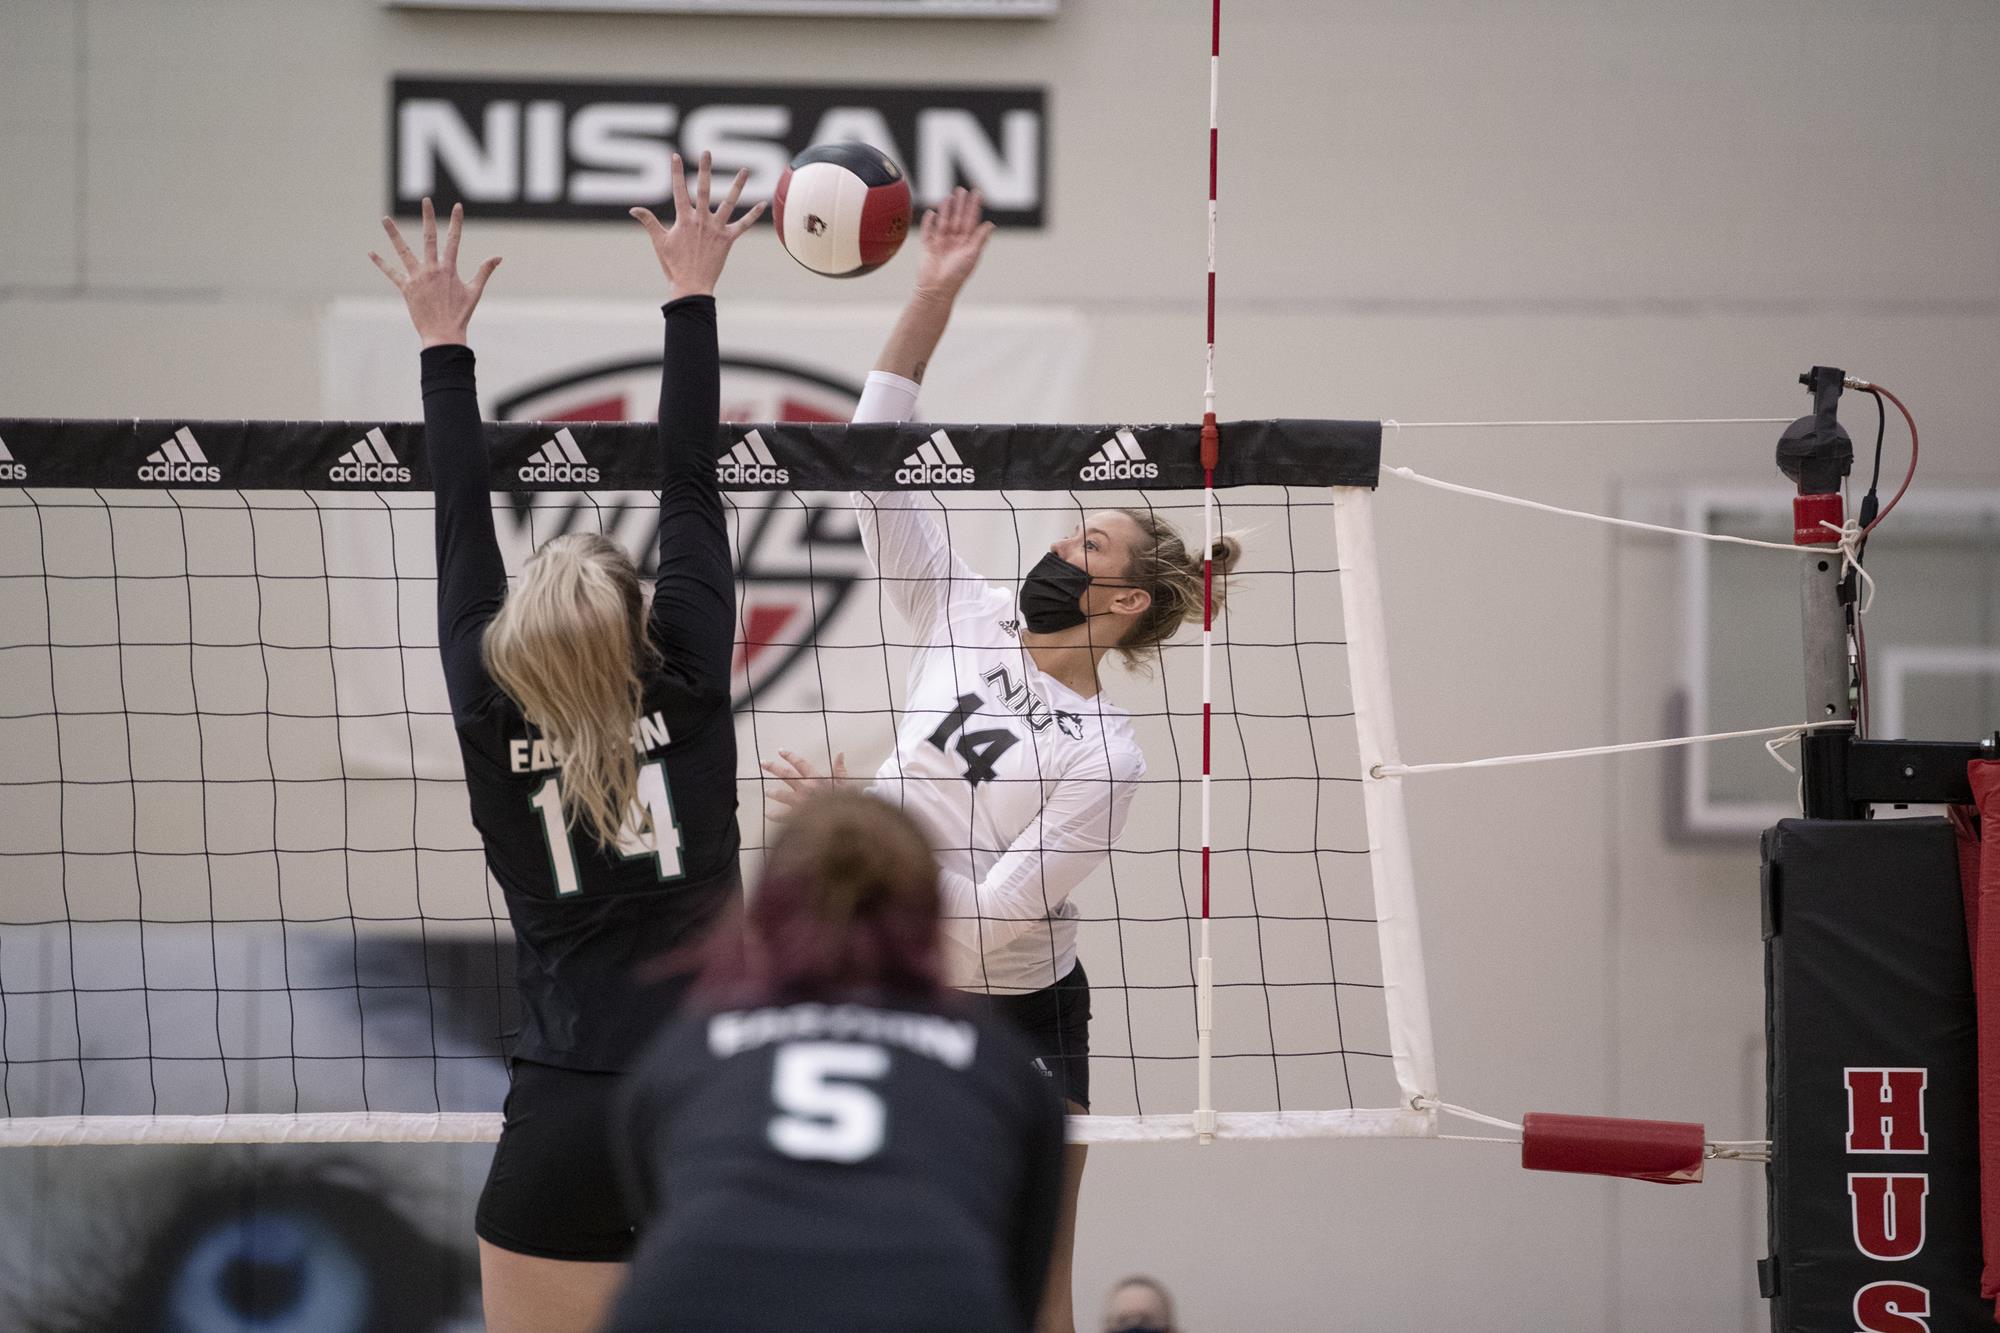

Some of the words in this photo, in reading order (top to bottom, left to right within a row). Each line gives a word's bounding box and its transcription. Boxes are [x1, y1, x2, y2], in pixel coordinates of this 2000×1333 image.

[137, 459, 221, 482] adidas
[328, 460, 412, 483] adidas
[518, 460, 600, 483] adidas
[715, 463, 790, 484] adidas
[895, 462, 976, 485] adidas
[1079, 460, 1159, 482] adidas
[979, 662, 1053, 733] NIU
[927, 692, 1020, 788] 14
[529, 758, 686, 898] 14
[766, 1039, 891, 1164] 5
